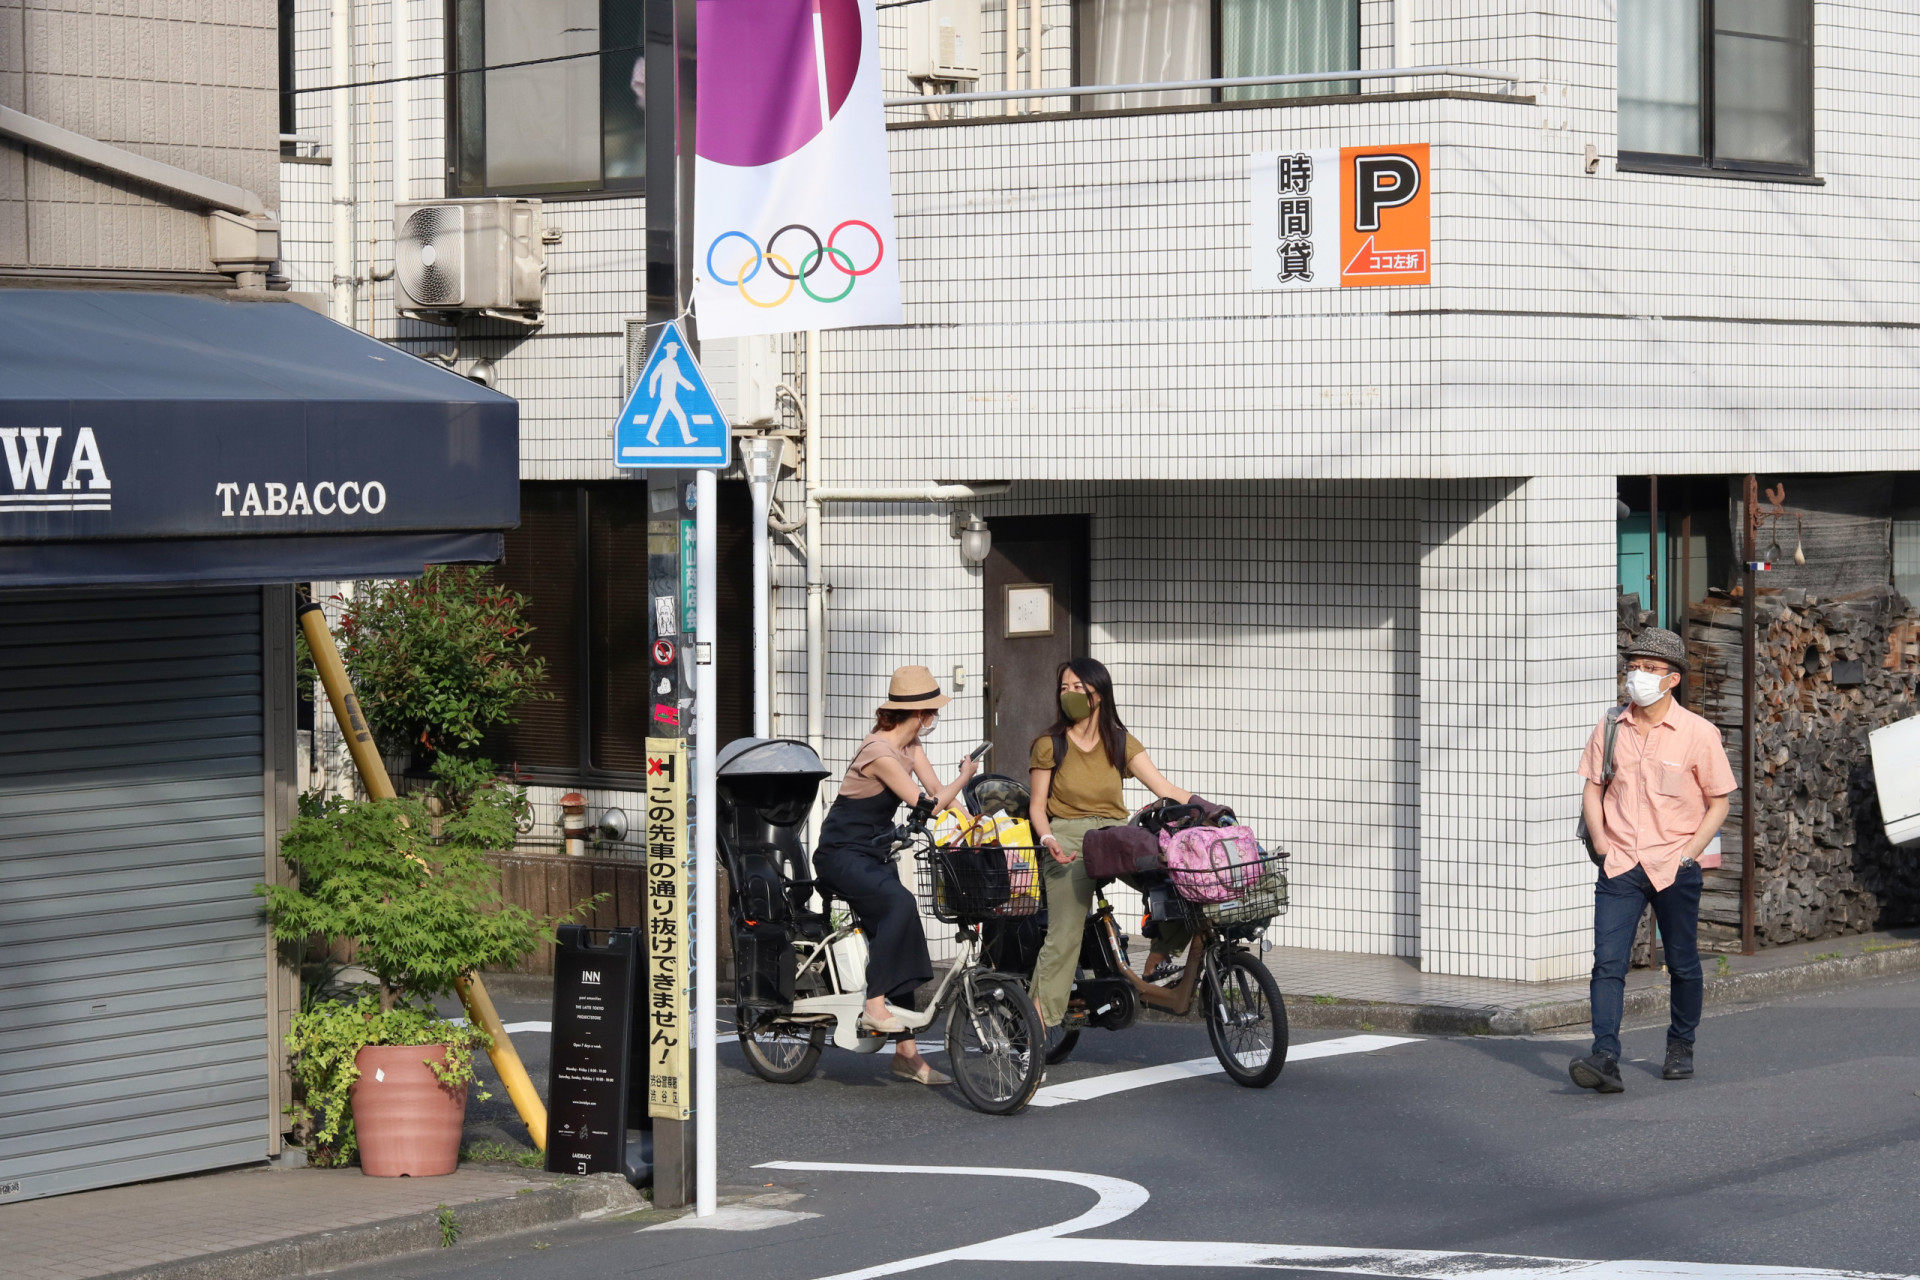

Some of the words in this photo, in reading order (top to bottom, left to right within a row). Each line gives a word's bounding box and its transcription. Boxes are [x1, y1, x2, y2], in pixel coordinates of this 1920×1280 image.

[1354, 153, 1421, 233] P
[1277, 152, 1314, 283] 時間貸
[1369, 254, 1419, 270] ココ左折
[215, 481, 387, 517] TABACCO
[582, 971, 601, 982] INN
